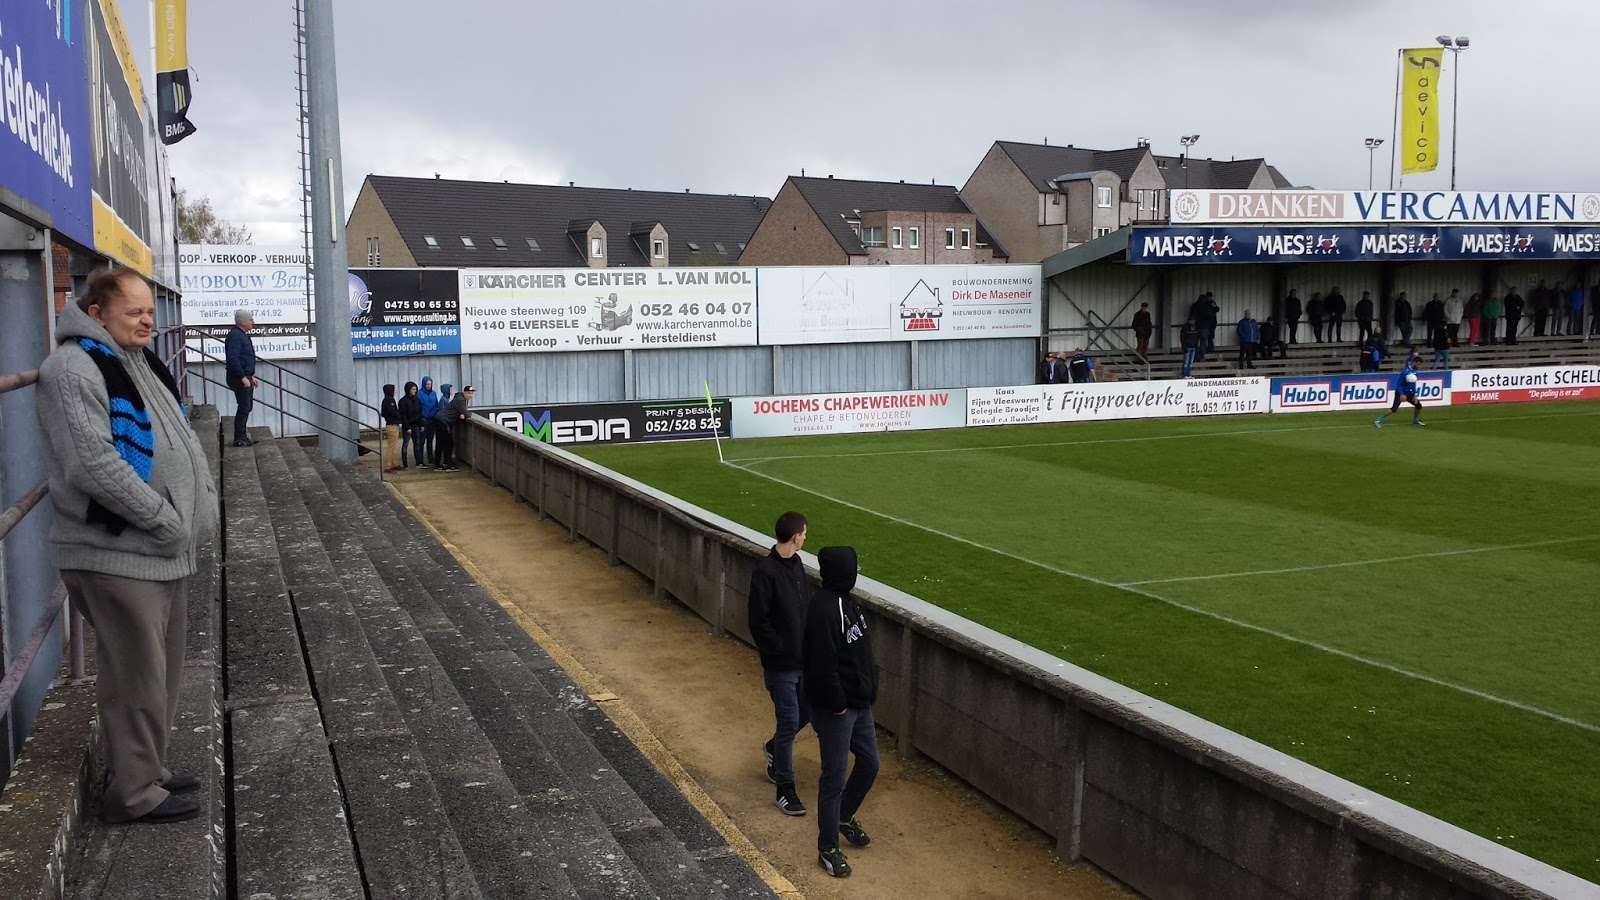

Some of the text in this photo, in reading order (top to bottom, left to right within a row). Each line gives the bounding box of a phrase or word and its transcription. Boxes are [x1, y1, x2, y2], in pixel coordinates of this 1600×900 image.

[0, 44, 74, 189] ederale.be
[1217, 194, 1337, 218] DRANKEN
[1354, 192, 1576, 220] VERCAMMEN
[1142, 235, 1197, 257] MAES
[1255, 234, 1313, 255] MAES PILS
[1361, 233, 1408, 254] MAES
[1461, 233, 1504, 253] MAES
[1552, 233, 1594, 253] MAES
[180, 253, 201, 264] OOP
[209, 253, 257, 264] VERKOOP
[183, 275, 266, 289] MOBOUW
[574, 272, 647, 287] CENTER
[675, 271, 709, 285] VAN
[714, 271, 752, 285] MOL
[952, 278, 1033, 286] BOUWONDERNEMING
[952, 289, 1032, 300] Dirk De Maseneir
[182, 298, 238, 307] odkruisstraat
[239, 298, 249, 307] 25
[256, 298, 274, 306] 9220
[276, 298, 307, 306] HAMME
[384, 300, 457, 309] 0475 90 65 53
[640, 302, 752, 317] 052 46 04 07
[199, 310, 231, 318] Tel/Fax:
[464, 305, 587, 317] Nieuwe steenweg 109
[383, 313, 457, 324] www.avgconsulting.be
[473, 319, 579, 330] 9140 ELVERSELE
[636, 318, 752, 331] www.karchervanmol.be
[267, 326, 283, 334] ook
[402, 327, 458, 339] Energieadvies
[508, 336, 557, 348] Verkoop
[577, 335, 623, 345] Verhuur
[641, 332, 717, 344] Hersteldienst
[1186, 379, 1249, 388] MANDEMAKERSTR.
[1471, 372, 1548, 388] Restaurant
[1207, 389, 1239, 399] HAMME
[1283, 387, 1328, 403] Hubo
[1342, 384, 1385, 401] Hubo
[1414, 382, 1441, 398] ubo
[1470, 392, 1499, 401] HAMME
[1540, 388, 1559, 399] paling
[753, 393, 949, 415] JOCHEMS CHAPEWERKEN NV
[993, 397, 1039, 405] Vleeswaren
[1061, 385, 1184, 415] Fijnproeverke
[1186, 402, 1218, 414] TEL.052
[1235, 401, 1245, 412] 16
[1248, 400, 1258, 411] 17
[645, 409, 676, 418] PRINT
[685, 406, 721, 415] DESIGN
[793, 410, 912, 424] CHAPE & BETONVLOEREN
[645, 417, 722, 433] 052/528 525
